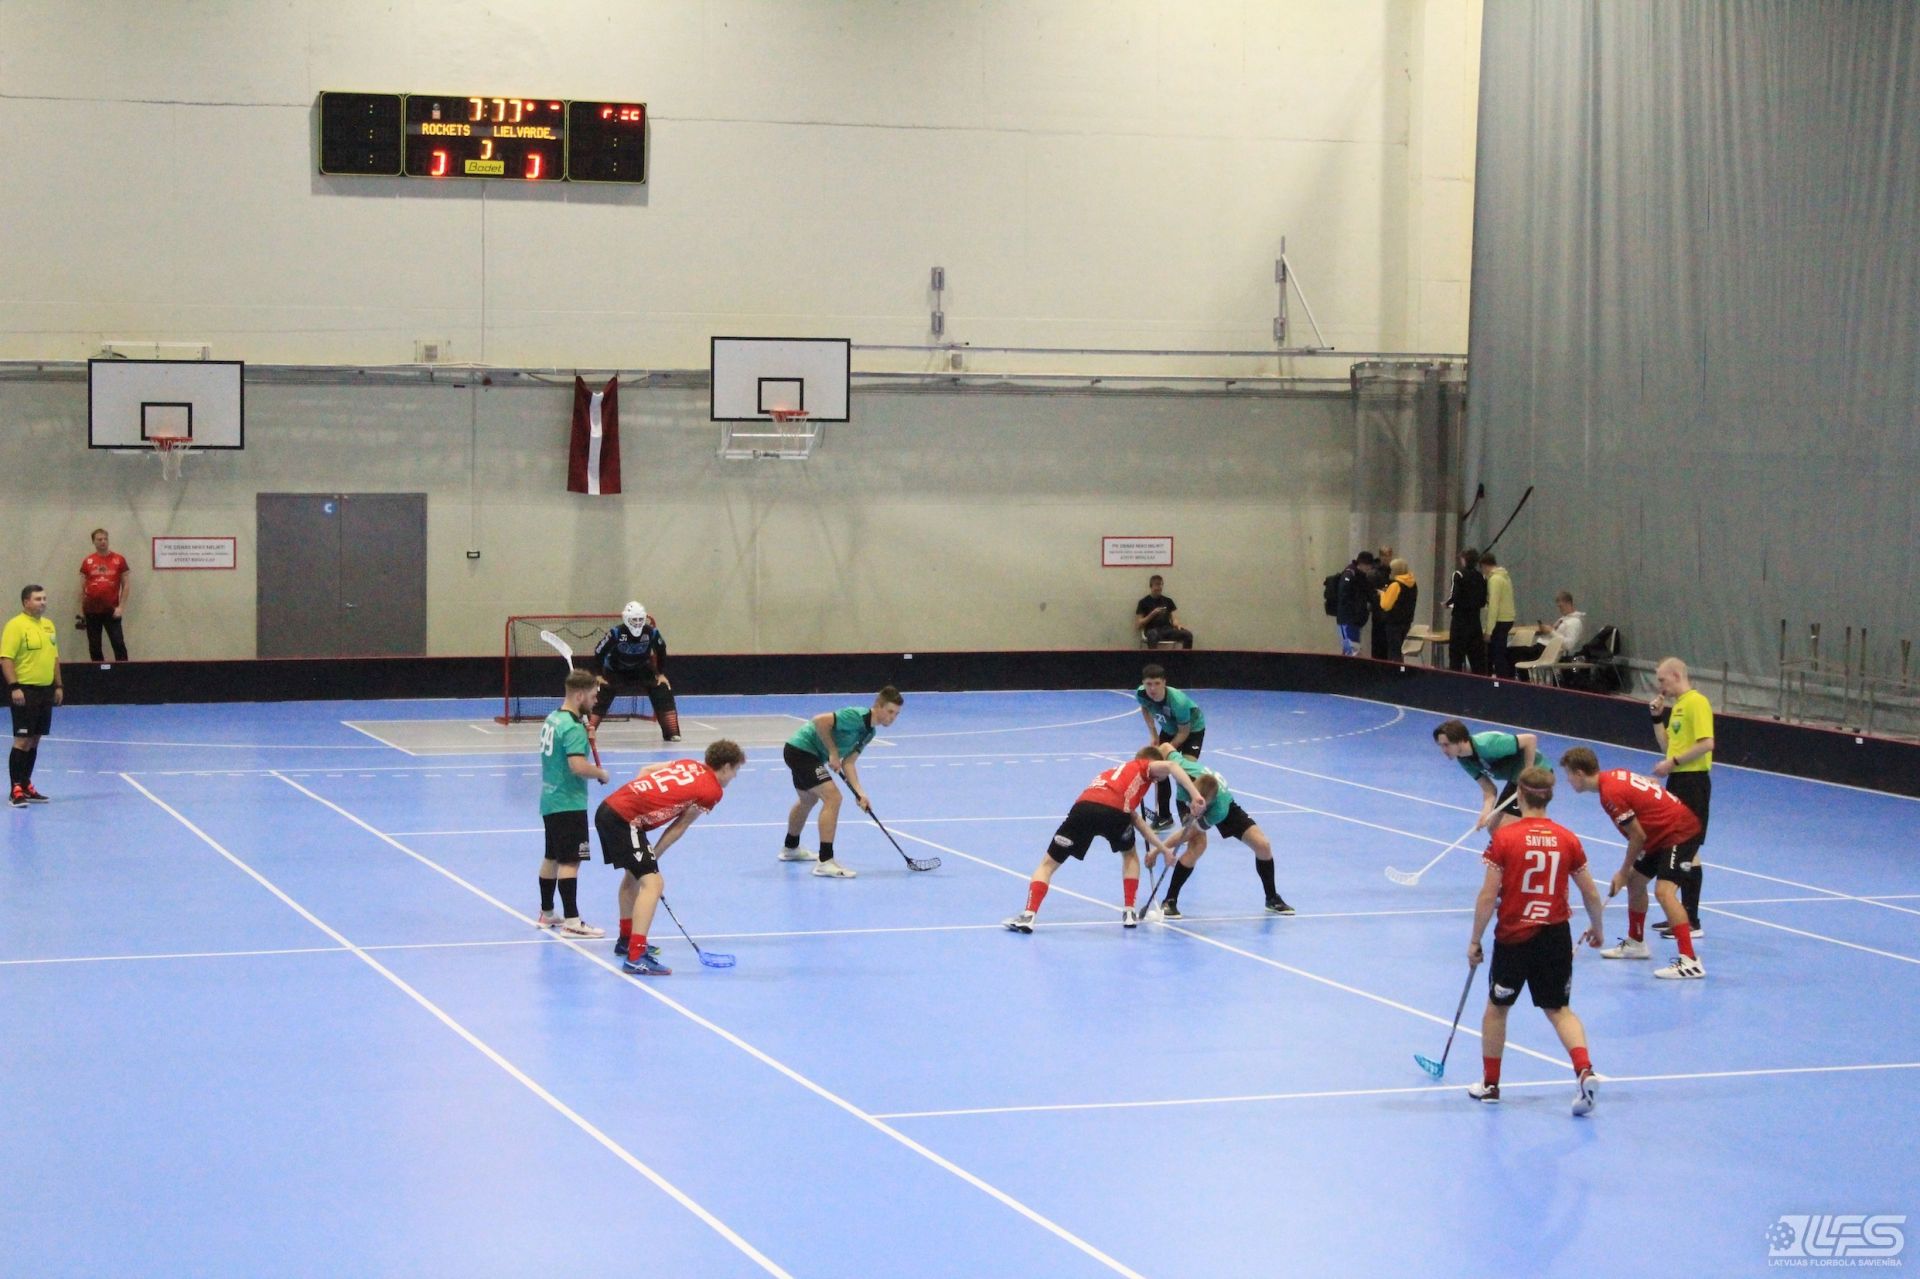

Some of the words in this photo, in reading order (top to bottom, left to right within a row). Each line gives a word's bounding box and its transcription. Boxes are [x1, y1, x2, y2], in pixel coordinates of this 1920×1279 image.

[421, 123, 471, 136] ROCKETS
[467, 162, 502, 173] Bodet
[1521, 850, 1561, 895] 21
